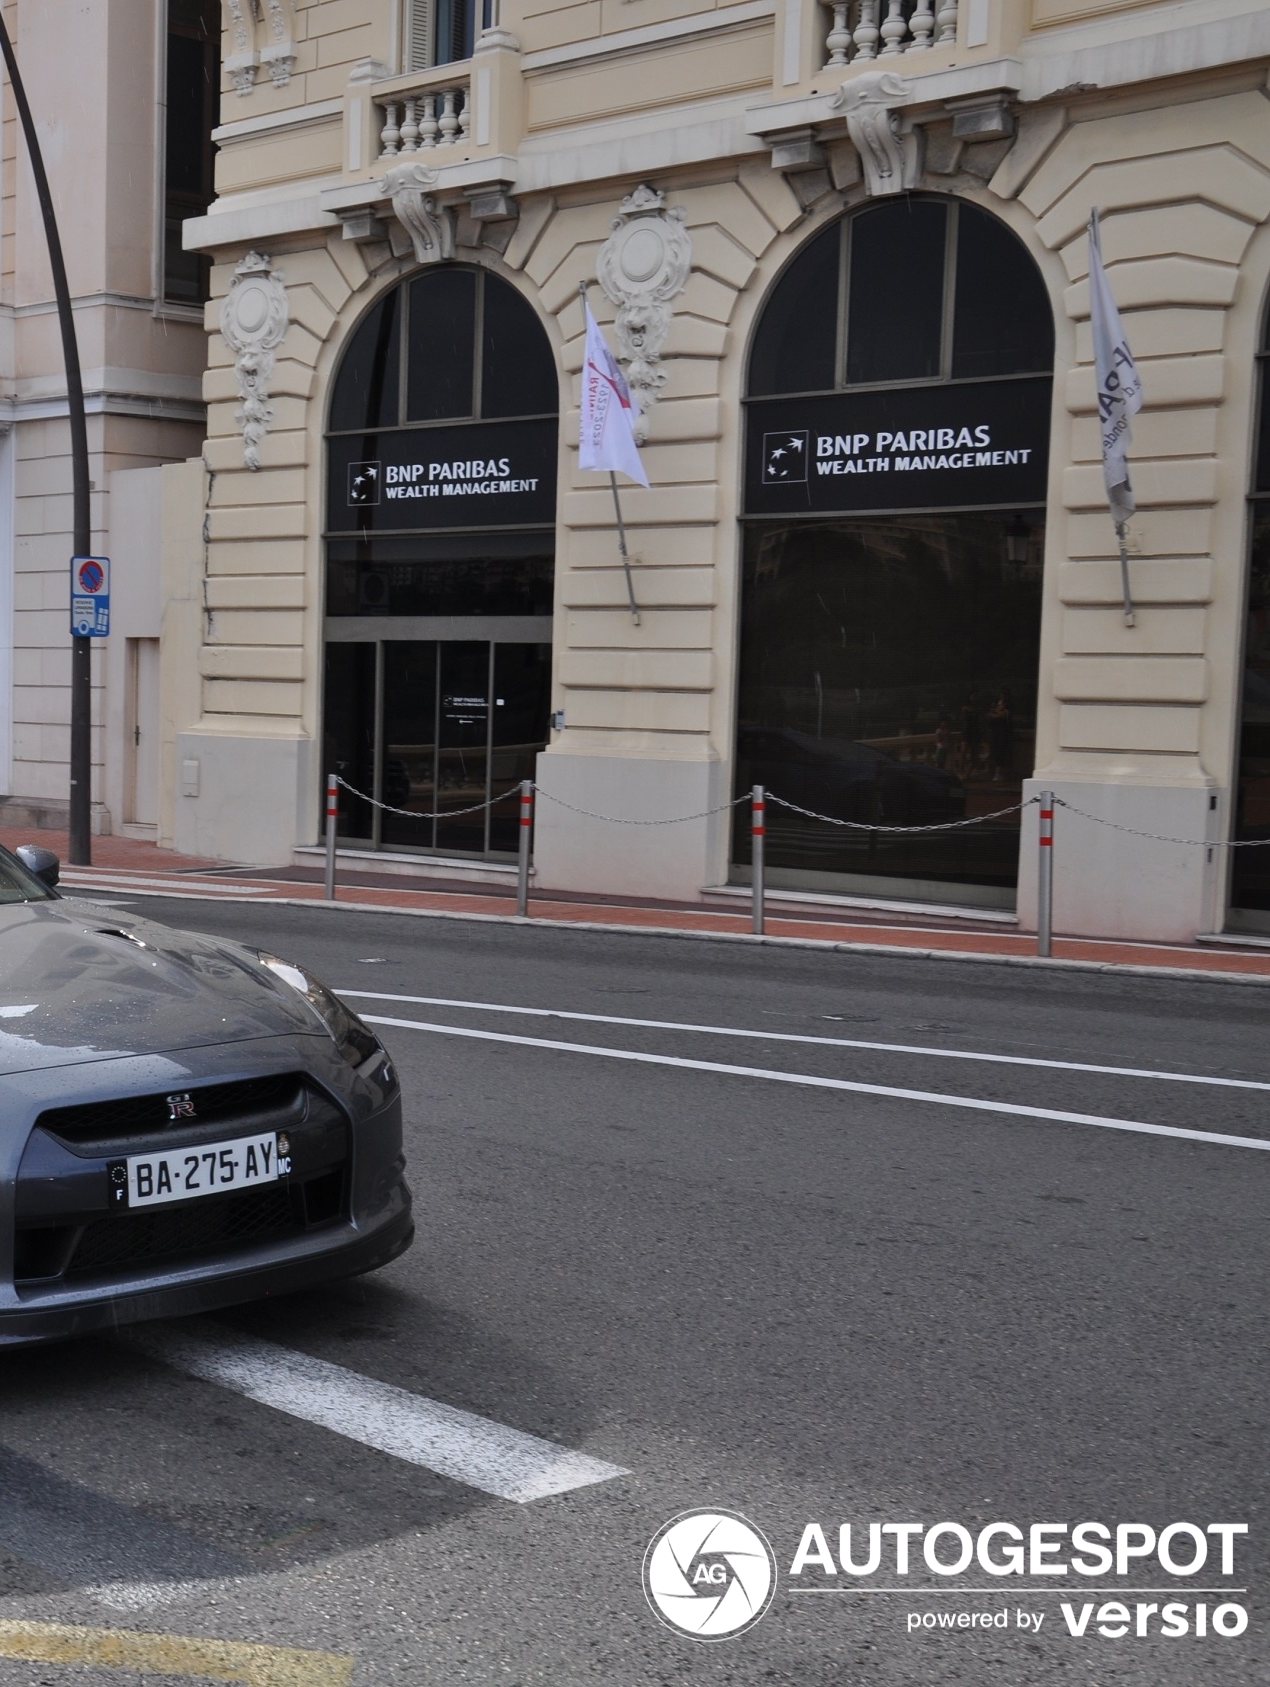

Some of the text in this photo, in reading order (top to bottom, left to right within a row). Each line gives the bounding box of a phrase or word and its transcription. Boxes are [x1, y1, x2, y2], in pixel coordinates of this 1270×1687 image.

[816, 425, 991, 457] BNP PARIBAS
[386, 458, 511, 484] BNP PARIBAS
[816, 449, 1032, 475] WEALTH MANAGEMENT
[386, 478, 539, 499] WEALTH MANAGEMENT
[278, 1157, 292, 1175] MC
[116, 1189, 124, 1200] F
